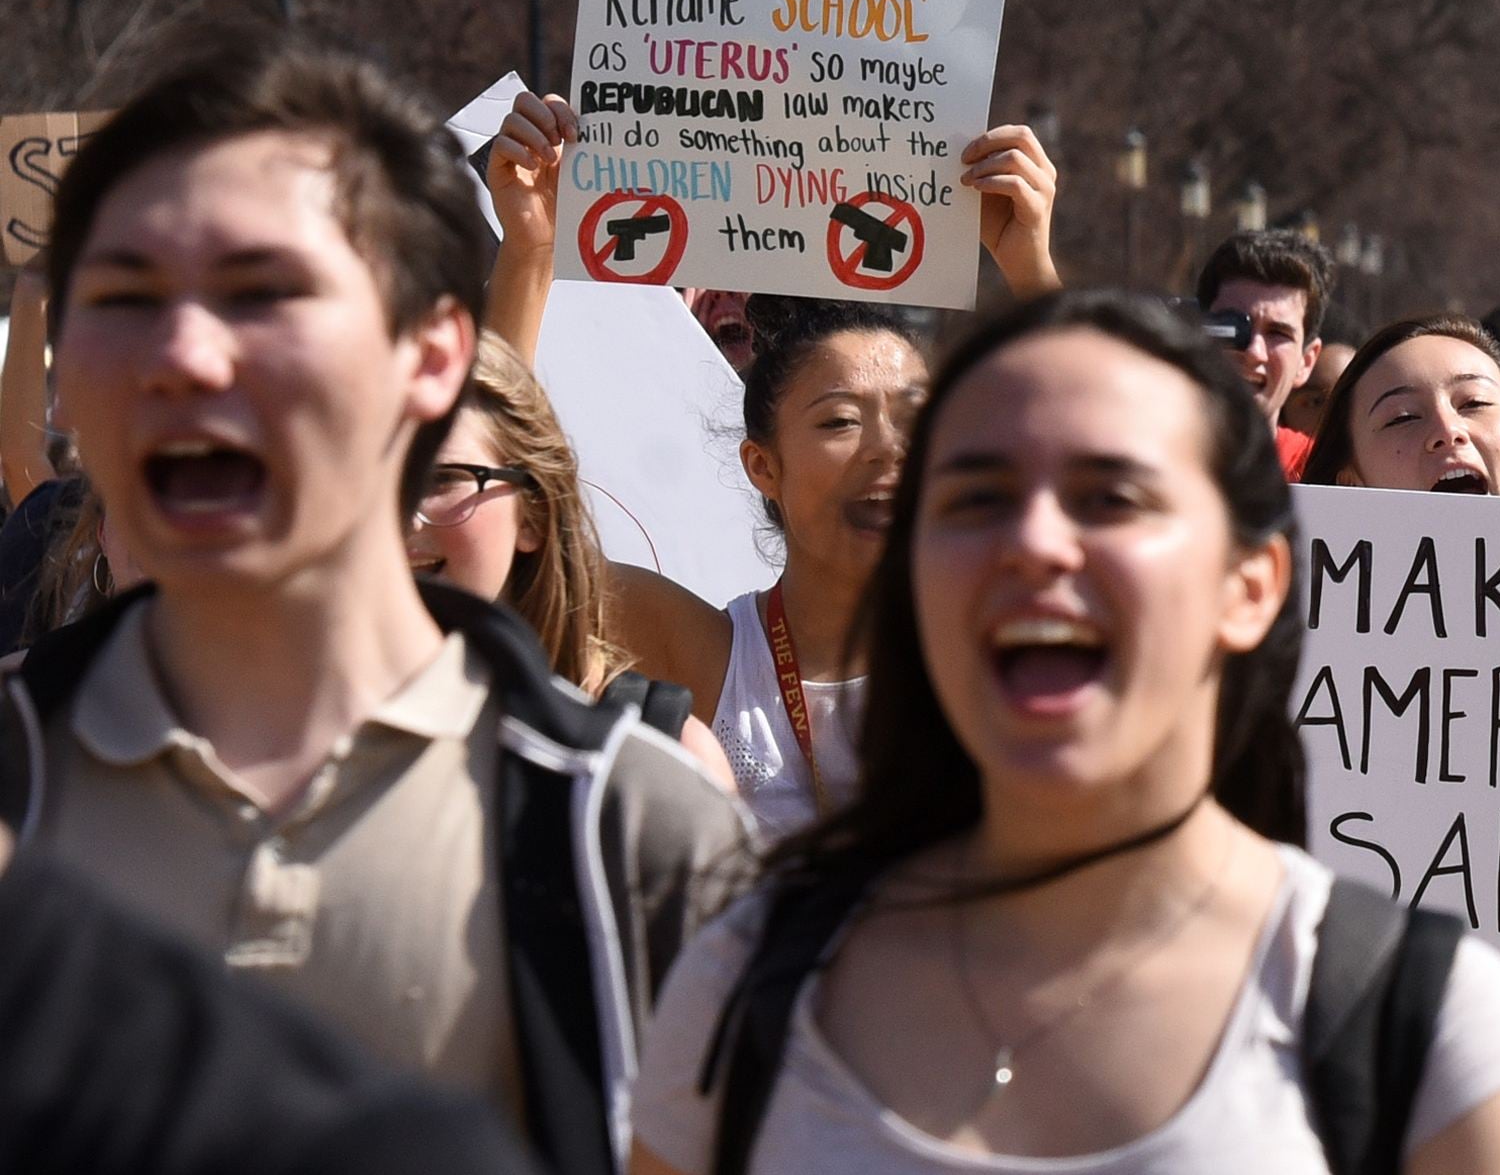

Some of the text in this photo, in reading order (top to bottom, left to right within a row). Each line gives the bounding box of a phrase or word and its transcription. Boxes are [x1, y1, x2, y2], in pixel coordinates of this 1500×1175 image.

[588, 41, 627, 72] as
[643, 32, 798, 84] 'UTERUS'
[860, 56, 948, 91] maybe
[580, 80, 935, 122] REPUBLICAN law makers
[576, 121, 948, 170] will do something about the
[572, 152, 953, 208] CHILDREN DYING inside
[718, 213, 805, 252] them
[771, 619, 793, 666] THE
